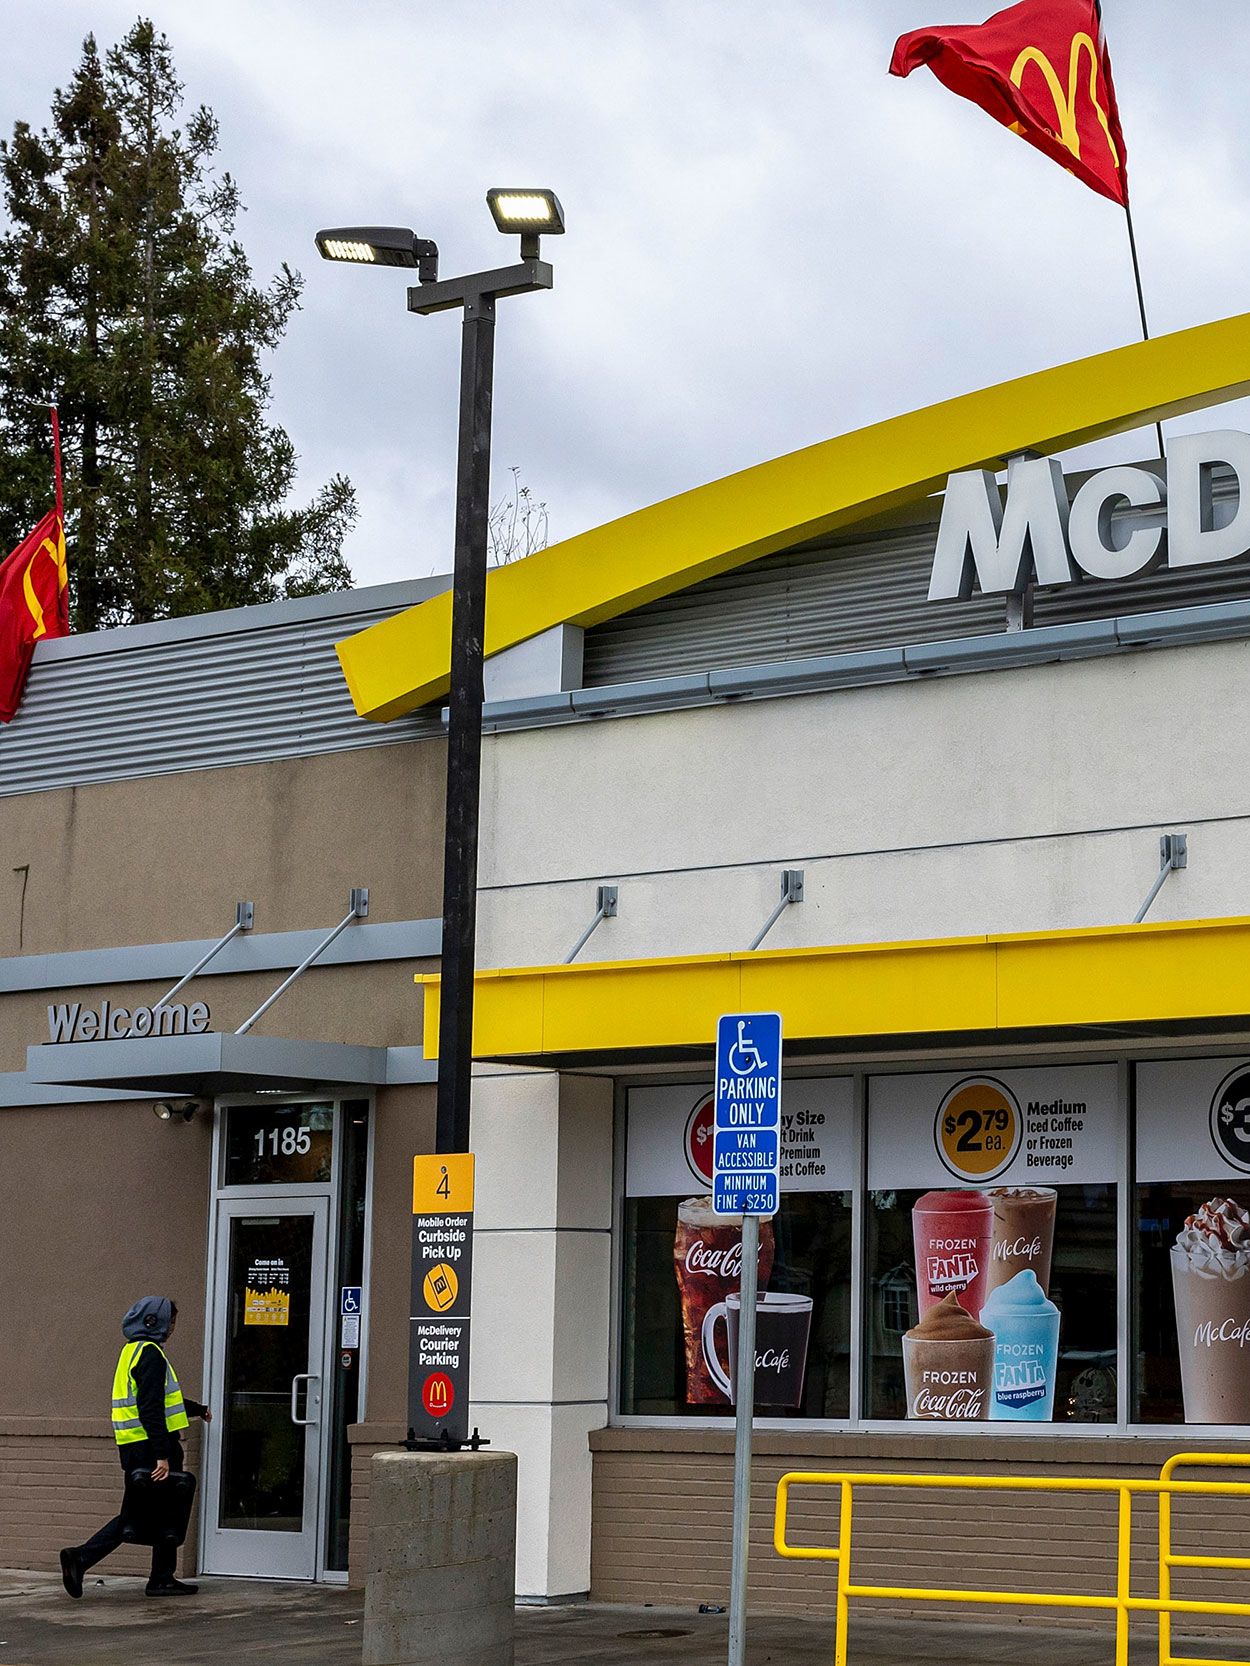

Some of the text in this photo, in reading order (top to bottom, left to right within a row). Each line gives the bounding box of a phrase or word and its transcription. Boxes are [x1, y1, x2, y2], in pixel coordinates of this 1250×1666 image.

[48, 1001, 210, 1043] Welcome
[720, 1076, 776, 1099] PARKING
[729, 1102, 765, 1125] ONLY
[1027, 1099, 1086, 1115] Medium
[796, 1109, 826, 1126] Size
[1027, 1117, 1084, 1133] Iced Coffee
[254, 1127, 311, 1156] 1185
[736, 1133, 756, 1148] VAN
[789, 1128, 815, 1143] Drink
[985, 1134, 1006, 1150] ea.
[1027, 1136, 1072, 1150] or Frozen
[718, 1152, 774, 1167] ACCESSIBLE
[780, 1145, 820, 1160] Premium
[795, 1163, 826, 1176] Coffee
[1027, 1154, 1074, 1170] Beverage
[436, 1174, 451, 1200] 4
[724, 1175, 767, 1190] MINIMUM
[717, 1194, 773, 1210] FINE $250
[418, 1217, 468, 1228] Mobile Order
[418, 1229, 466, 1243] Curbside
[929, 1238, 977, 1250] FROZEN
[992, 1236, 1041, 1262] McCafé
[422, 1246, 461, 1261] Pick Up
[685, 1240, 763, 1277] Coca-Co
[927, 1253, 979, 1281] FANTA
[930, 1281, 967, 1293] wild cherry
[417, 1325, 462, 1337] McDelivery
[420, 1337, 460, 1351] Courier
[996, 1344, 1044, 1356] FROZEN
[419, 1352, 460, 1369] Parking
[923, 1371, 977, 1384] FROZEN
[994, 1360, 1047, 1388] FANTA
[997, 1388, 1045, 1400] blue raspberry
[913, 1388, 985, 1418] Coca-Cola
